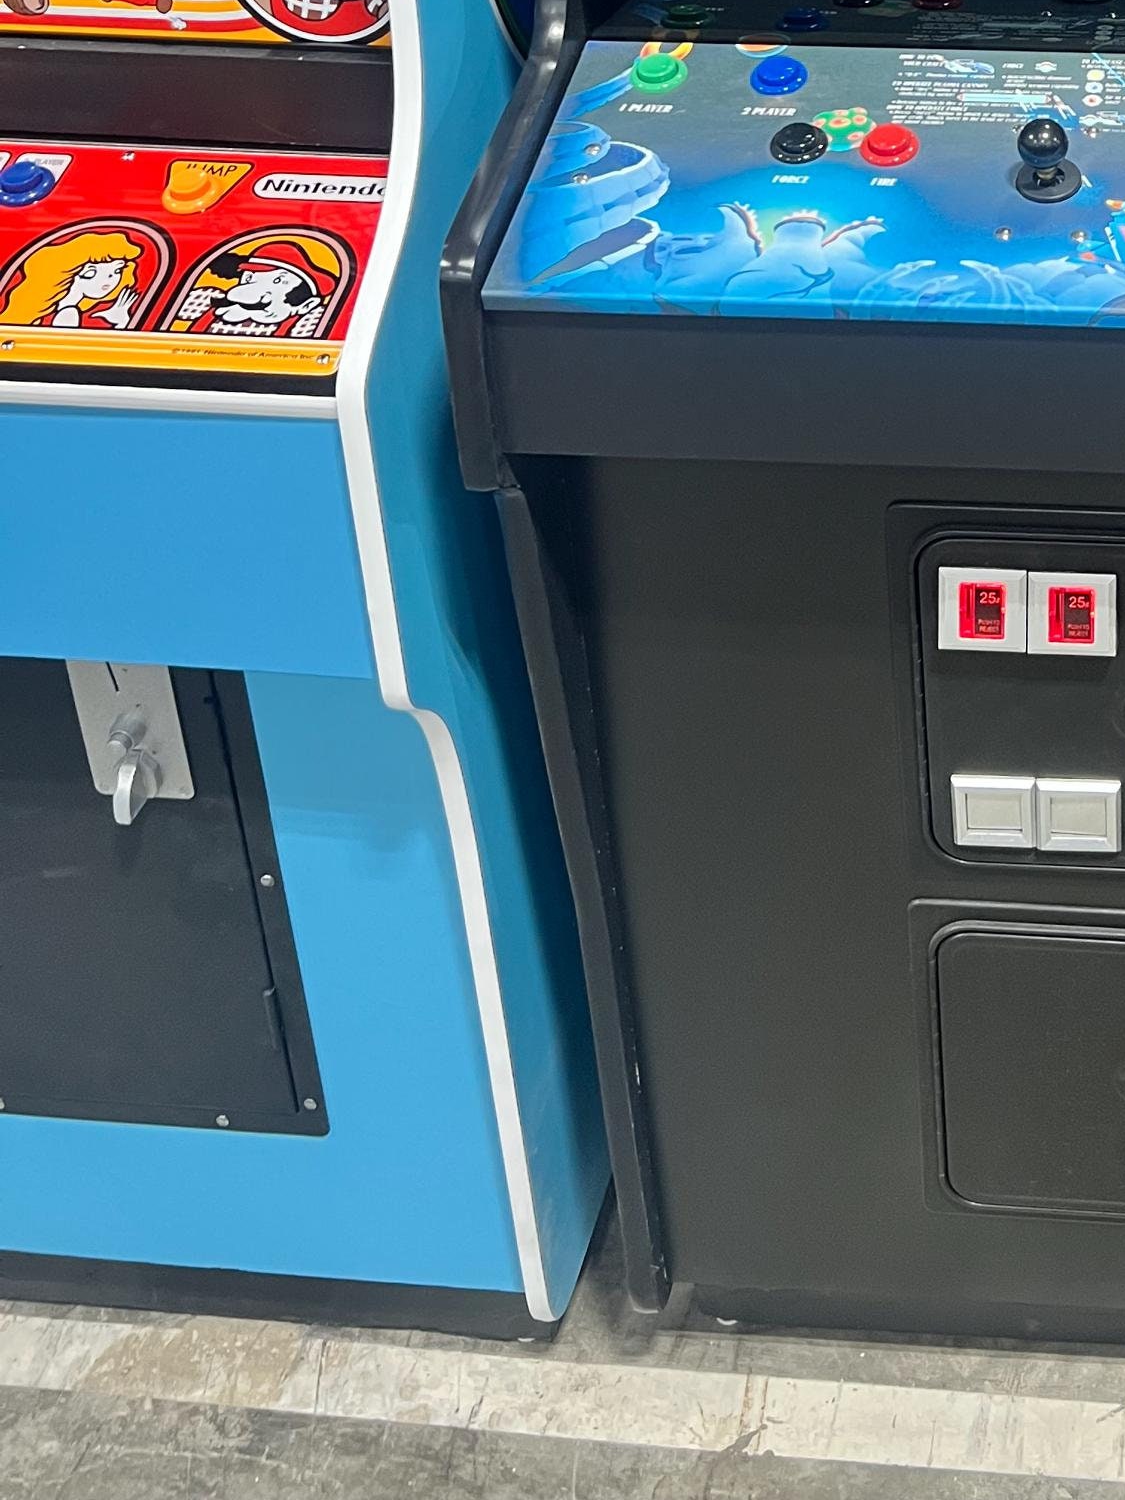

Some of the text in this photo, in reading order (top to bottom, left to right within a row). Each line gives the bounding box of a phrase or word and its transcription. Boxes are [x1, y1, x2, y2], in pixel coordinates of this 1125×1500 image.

[619, 103, 673, 114] 1 PLAYER
[740, 107, 797, 117] 2 PLAYER
[187, 162, 237, 177] MP
[771, 174, 898, 187] FORCE FIRE
